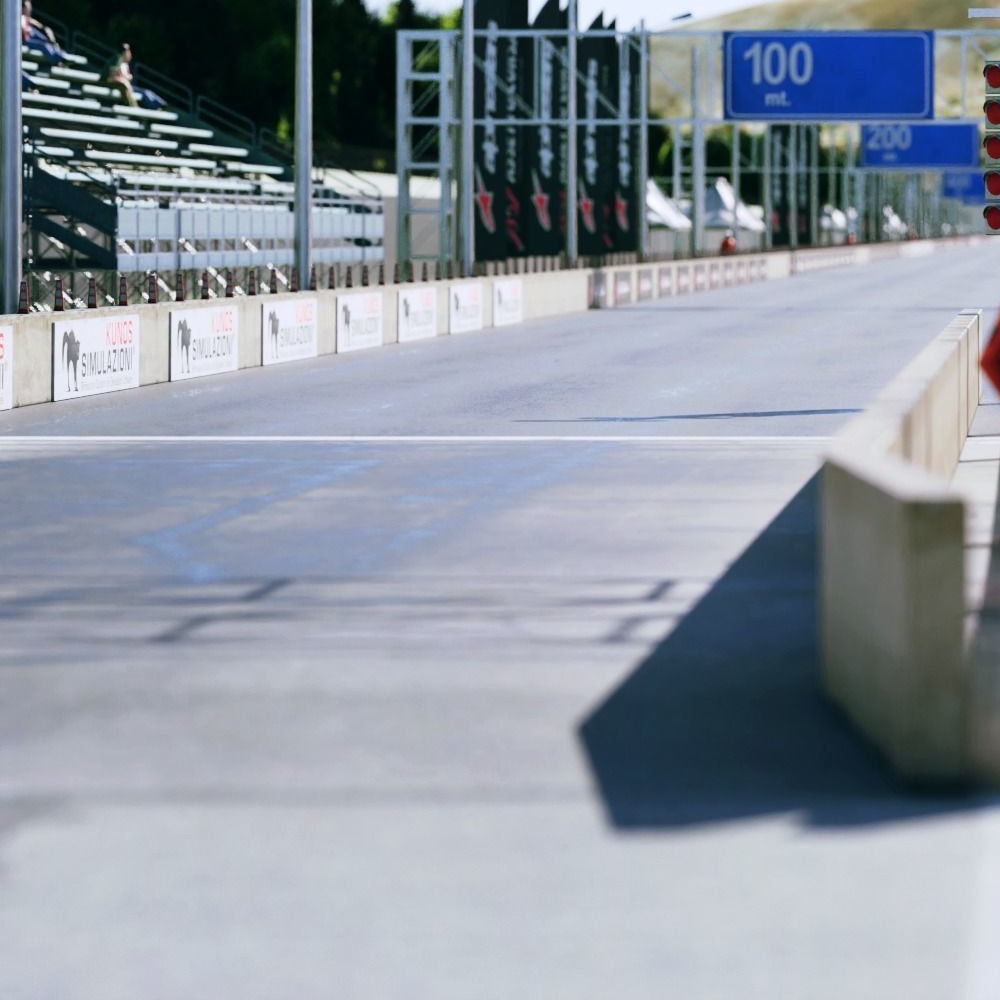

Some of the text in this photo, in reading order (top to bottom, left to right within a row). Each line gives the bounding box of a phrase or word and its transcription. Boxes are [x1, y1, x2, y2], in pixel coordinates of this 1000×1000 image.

[743, 41, 814, 85] 100
[765, 91, 791, 106] mt.
[867, 124, 912, 150] 200
[105, 320, 133, 346] KUNOS
[81, 347, 133, 378] SIMULAZIONI
